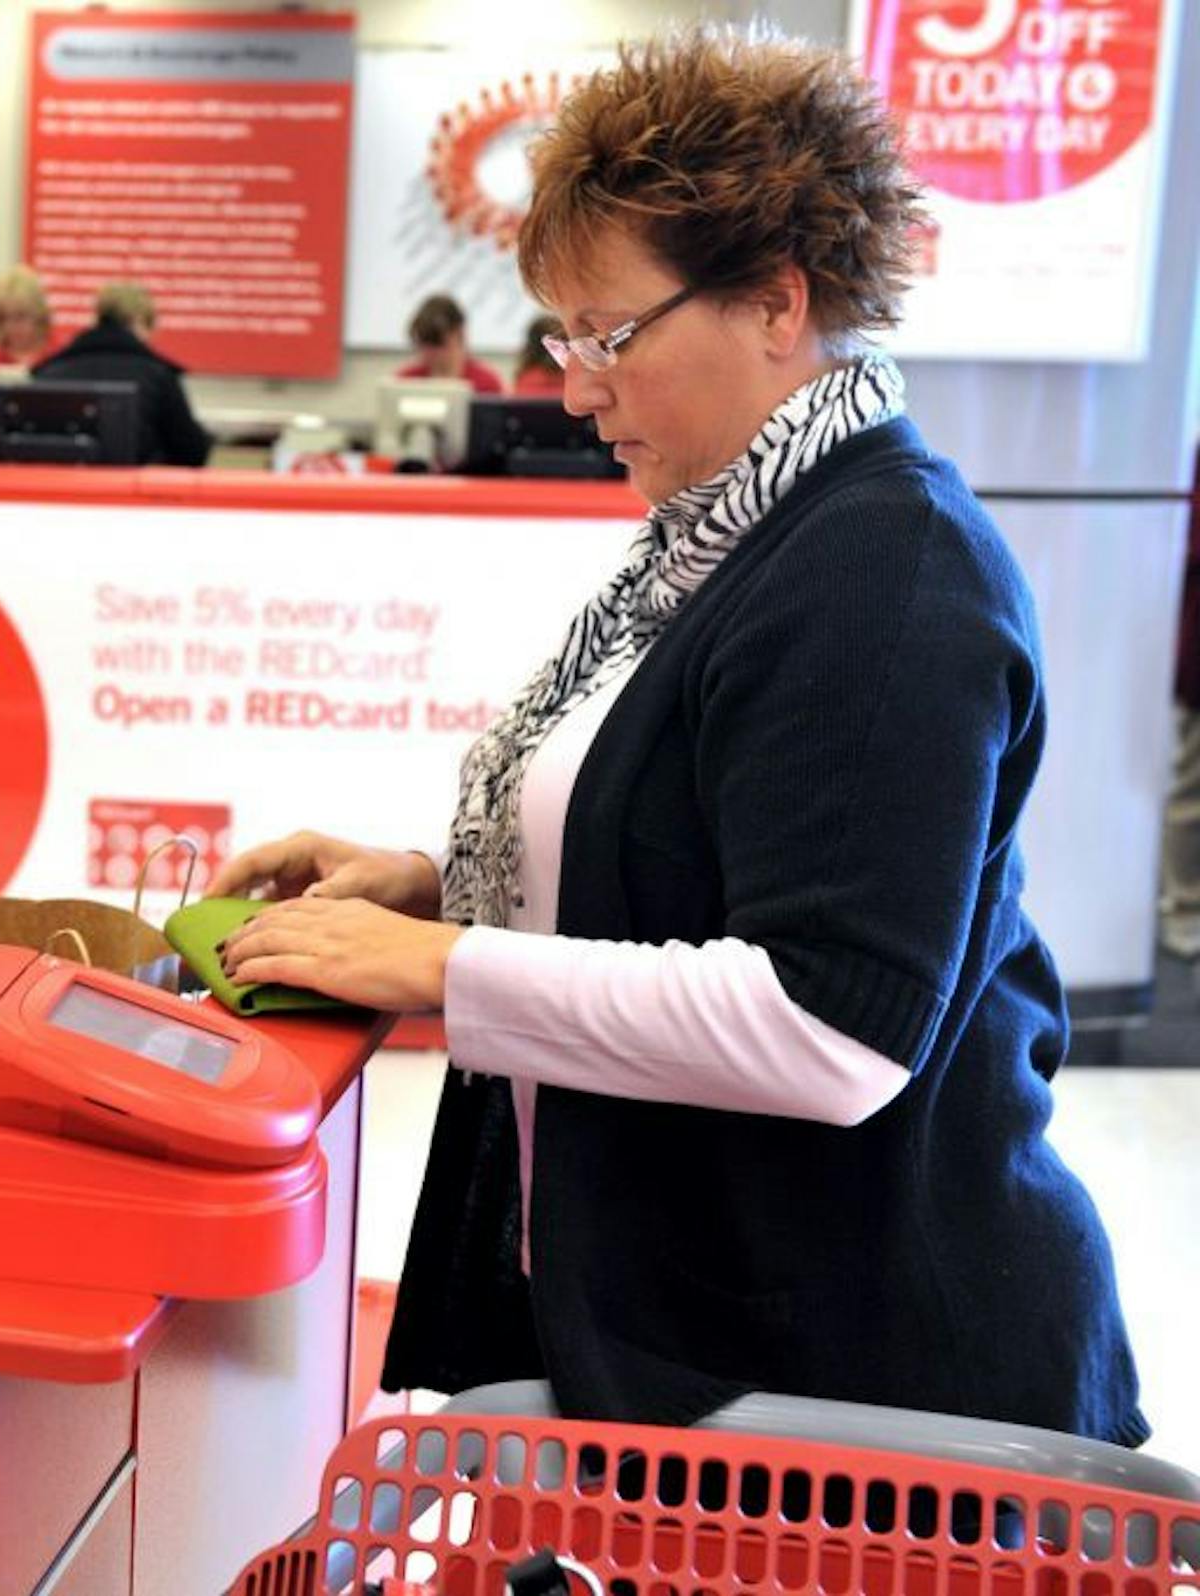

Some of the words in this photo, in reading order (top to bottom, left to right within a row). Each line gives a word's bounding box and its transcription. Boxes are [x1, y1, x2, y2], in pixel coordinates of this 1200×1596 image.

[1017, 9, 1117, 55] OFF
[909, 59, 1066, 109] TODAY
[904, 113, 1028, 152] EVERY
[1035, 113, 1111, 152] DAY
[95, 581, 180, 626] Save
[193, 586, 255, 626] 5%
[263, 597, 362, 635] every
[373, 595, 441, 639] day
[93, 638, 172, 675] with
[184, 638, 245, 677] the
[92, 685, 193, 730] Open
[206, 697, 229, 727] a
[245, 688, 411, 732] REDcard
